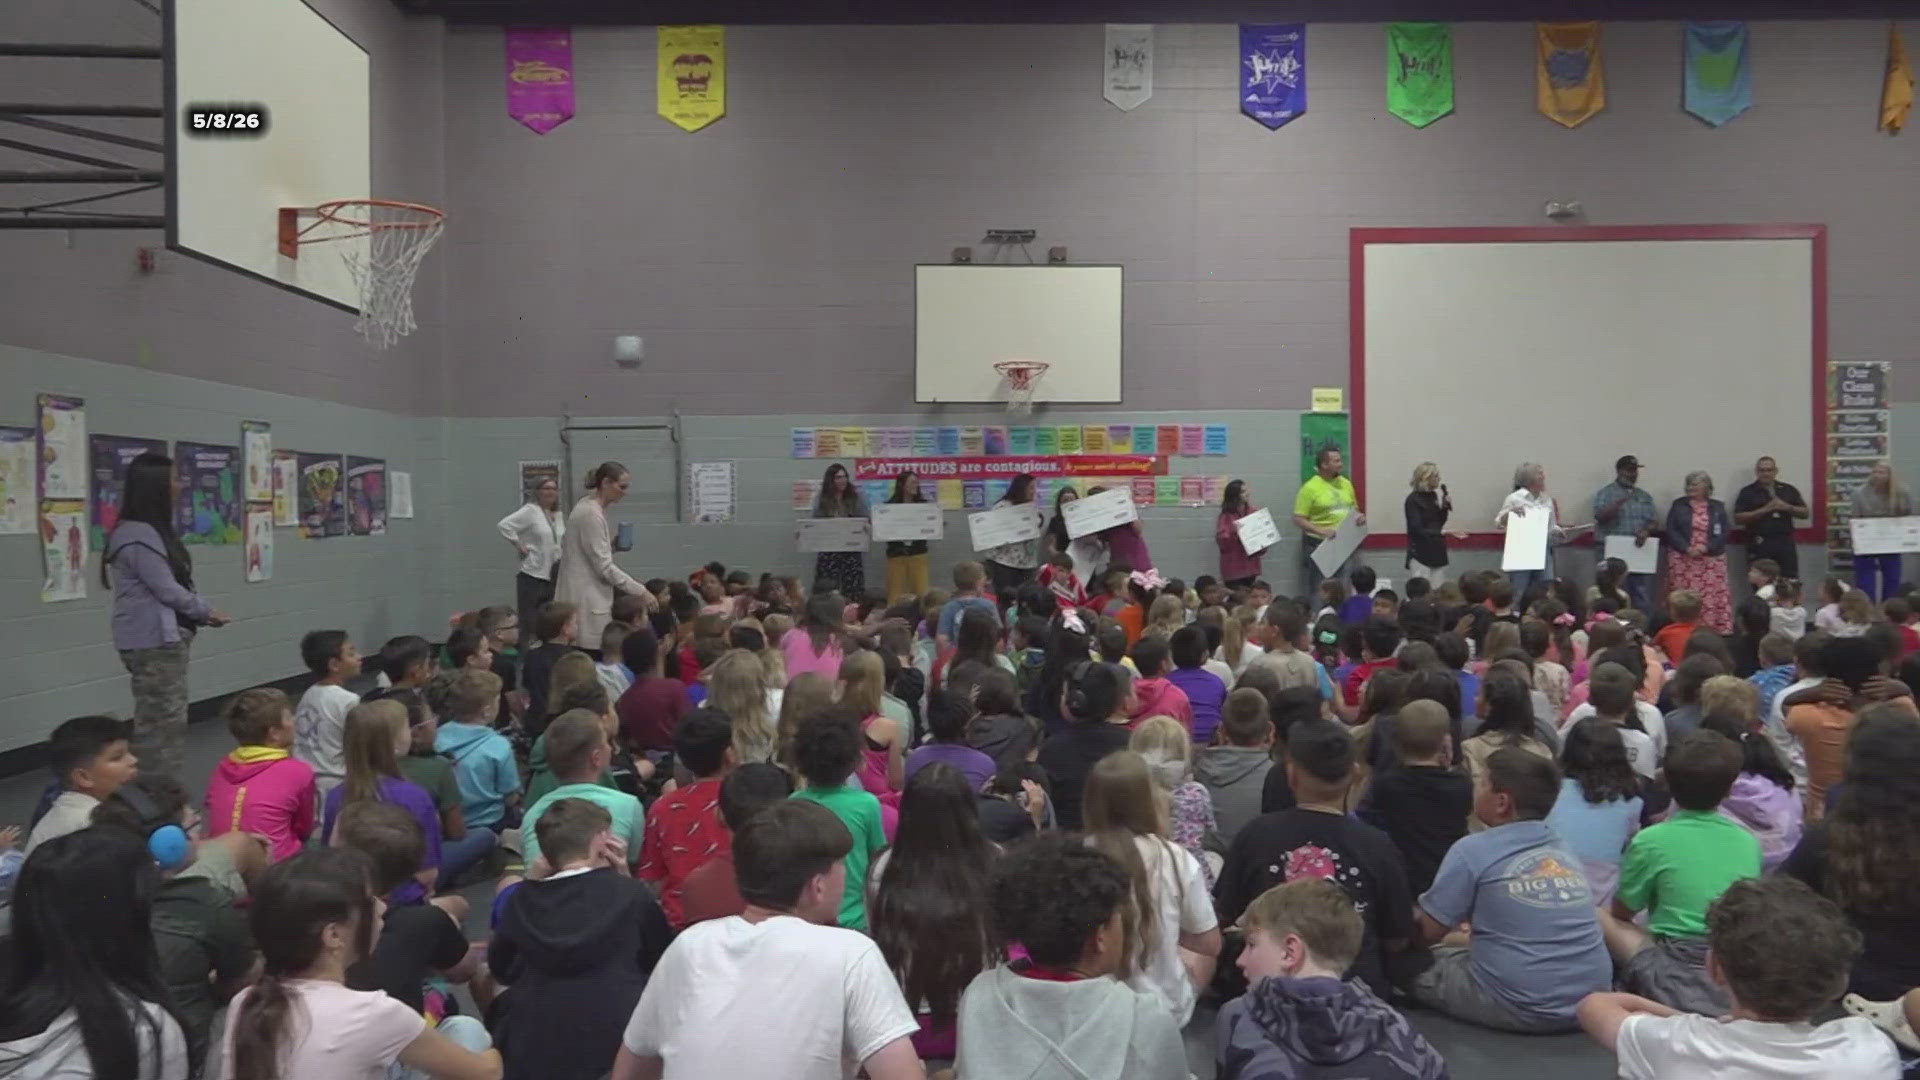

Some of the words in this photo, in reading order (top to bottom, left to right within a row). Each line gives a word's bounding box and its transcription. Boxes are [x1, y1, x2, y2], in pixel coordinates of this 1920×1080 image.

[877, 462, 957, 475] ATTITUDES
[960, 463, 982, 472] are
[984, 460, 1061, 474] contagious.
[1508, 879, 1547, 895] BIG
